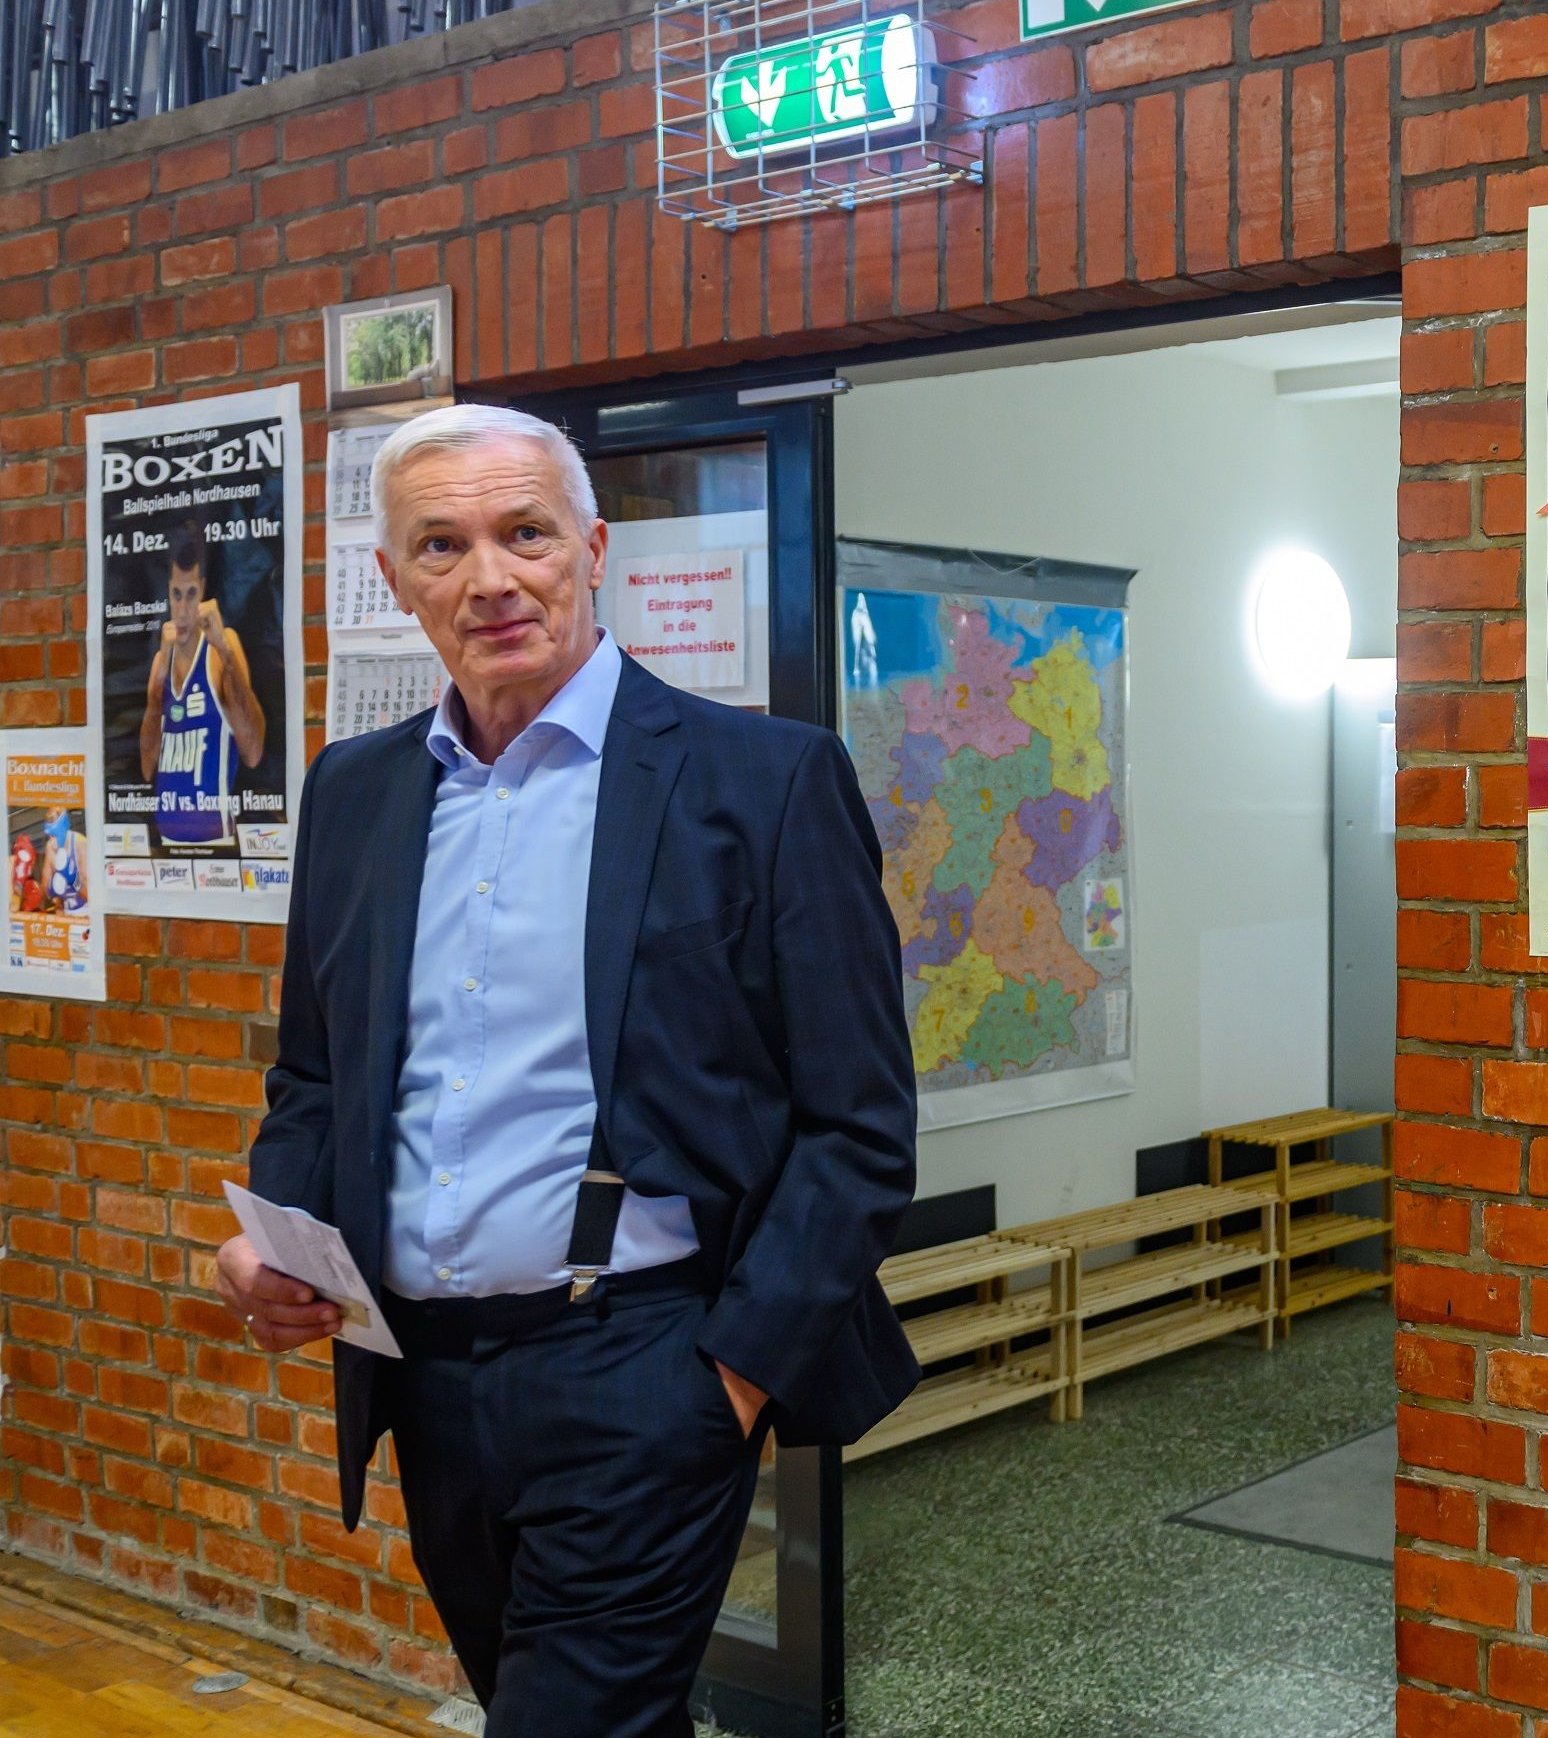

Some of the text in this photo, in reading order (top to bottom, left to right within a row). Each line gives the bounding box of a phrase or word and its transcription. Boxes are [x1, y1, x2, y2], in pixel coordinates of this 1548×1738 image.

[163, 428, 219, 448] Bundesliga
[102, 424, 284, 493] BOXEN
[123, 483, 261, 515] Ballspielhalle Nordhausen
[204, 518, 281, 543] 19.30 Uhr
[104, 531, 170, 556] 14. Dez.
[369, 578, 377, 589] 10
[628, 567, 732, 586] Nicht vergessen!!
[368, 590, 376, 600] 17
[354, 601, 388, 613] 23 24 25
[647, 598, 713, 612] Eintragung
[352, 615, 361, 625] 30
[663, 619, 697, 632] in die
[626, 639, 736, 656] Anwesenheitsliste
[407, 689, 415, 699] 10
[955, 683, 970, 710] 2
[355, 700, 414, 711] 13 14 15 16 17
[7, 760, 86, 777] Boxnacht
[108, 791, 160, 812] Nordhäuser
[161, 792, 177, 812] SV
[178, 796, 196, 812] vs.
[242, 790, 284, 811] Hanau
[933, 1007, 945, 1032] 7
